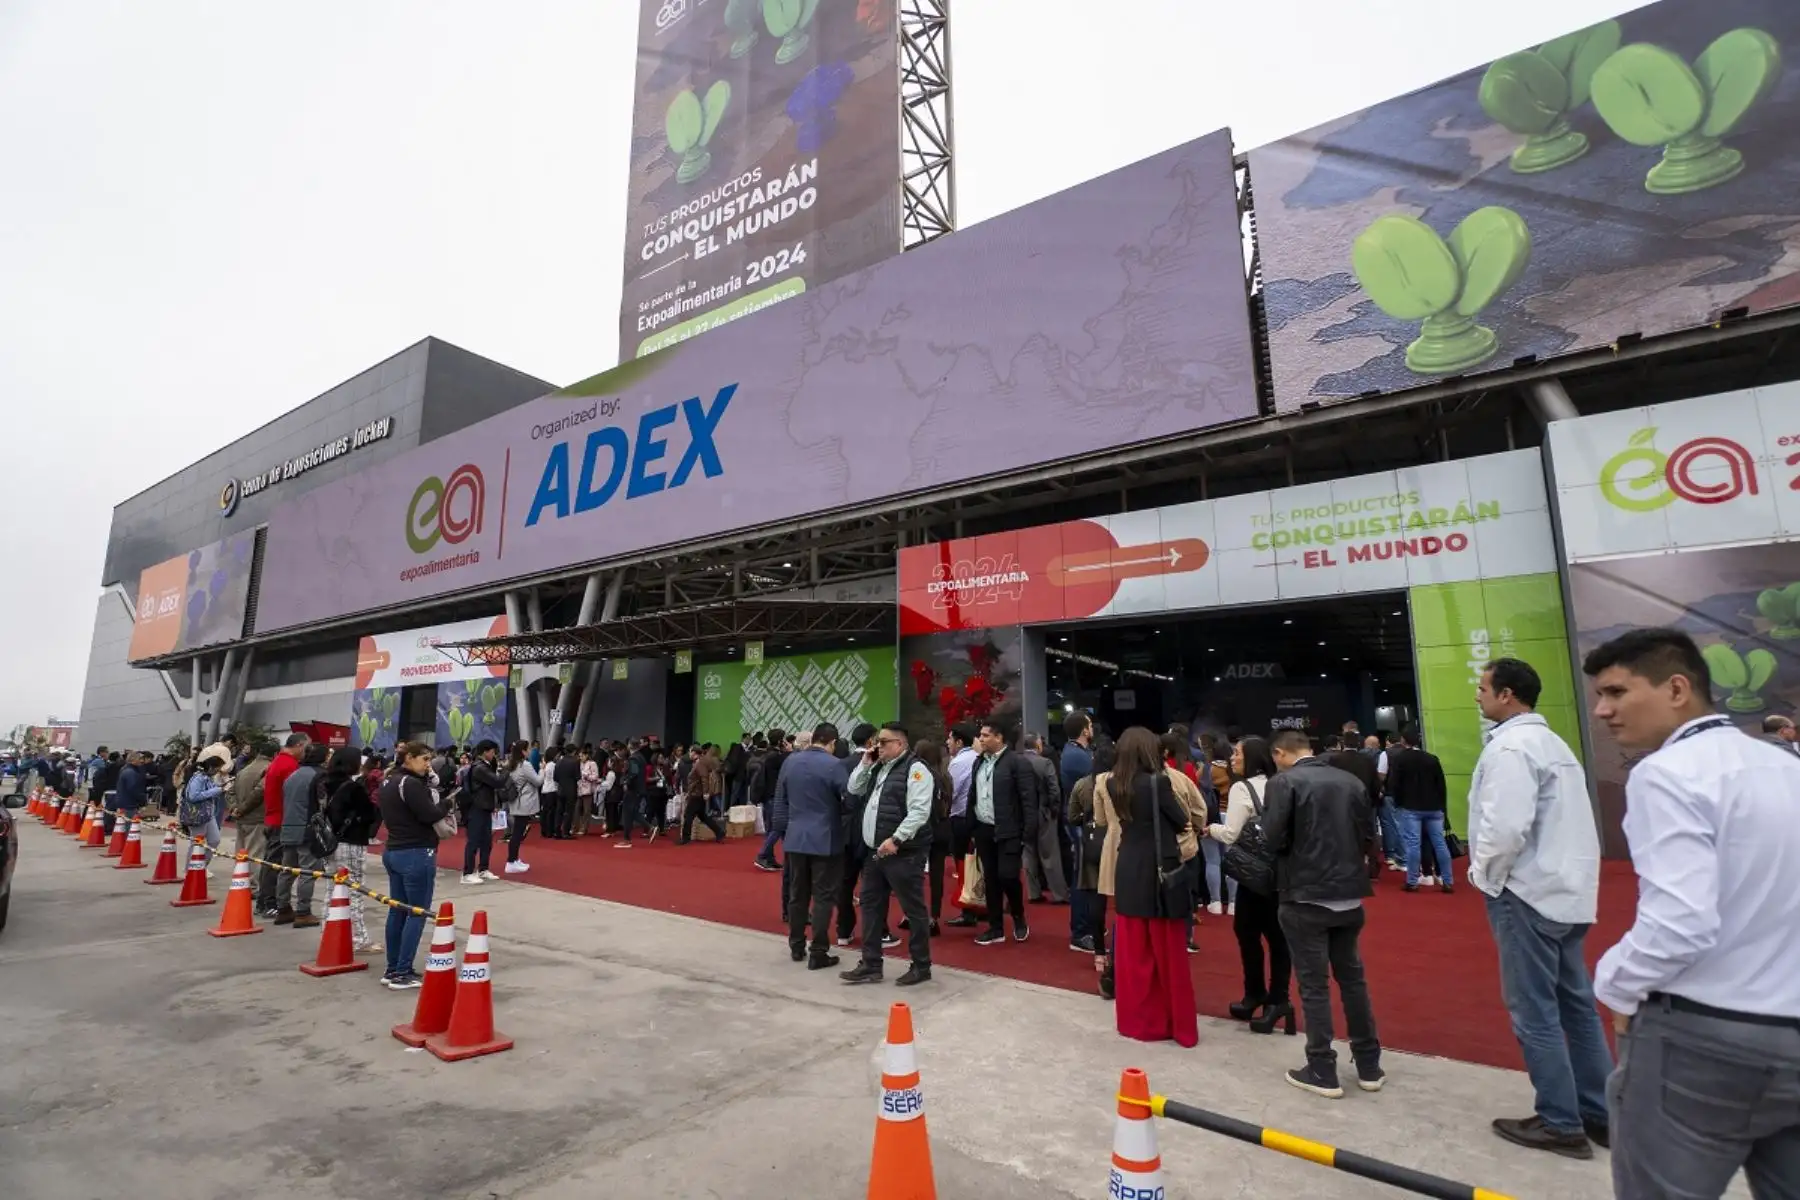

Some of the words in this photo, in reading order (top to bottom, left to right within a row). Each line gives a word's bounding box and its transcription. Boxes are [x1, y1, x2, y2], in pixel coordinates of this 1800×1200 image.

[641, 158, 817, 261] CONQUISTARÁN
[643, 214, 668, 239] TUS
[670, 166, 763, 225] PRODUCTOS
[694, 235, 721, 260] EL
[726, 186, 817, 245] MUNDO
[637, 275, 742, 332] Expoalimentaria
[745, 241, 807, 286] 2024
[651, 291, 674, 310] parte
[675, 283, 687, 296] de
[688, 279, 697, 290] la
[531, 403, 598, 440] Organized
[600, 397, 621, 417] by:
[283, 436, 349, 480] Exposiciones
[352, 416, 392, 449] Jockey
[524, 382, 740, 528] ADEX
[1251, 512, 1285, 528] TUS
[1290, 490, 1420, 523] PRODUCTOS
[1252, 499, 1501, 551] CONQUISTARÁN
[399, 549, 480, 582] expoalimentaria
[1303, 549, 1337, 569] EL
[1347, 532, 1469, 564] MUNDO
[927, 570, 1030, 593] EXPOALIMENTARIA
[400, 662, 454, 677] PROVEEDORES
[747, 647, 760, 660] 05
[1224, 662, 1276, 679] ADEX
[798, 661, 862, 739] WELCOM
